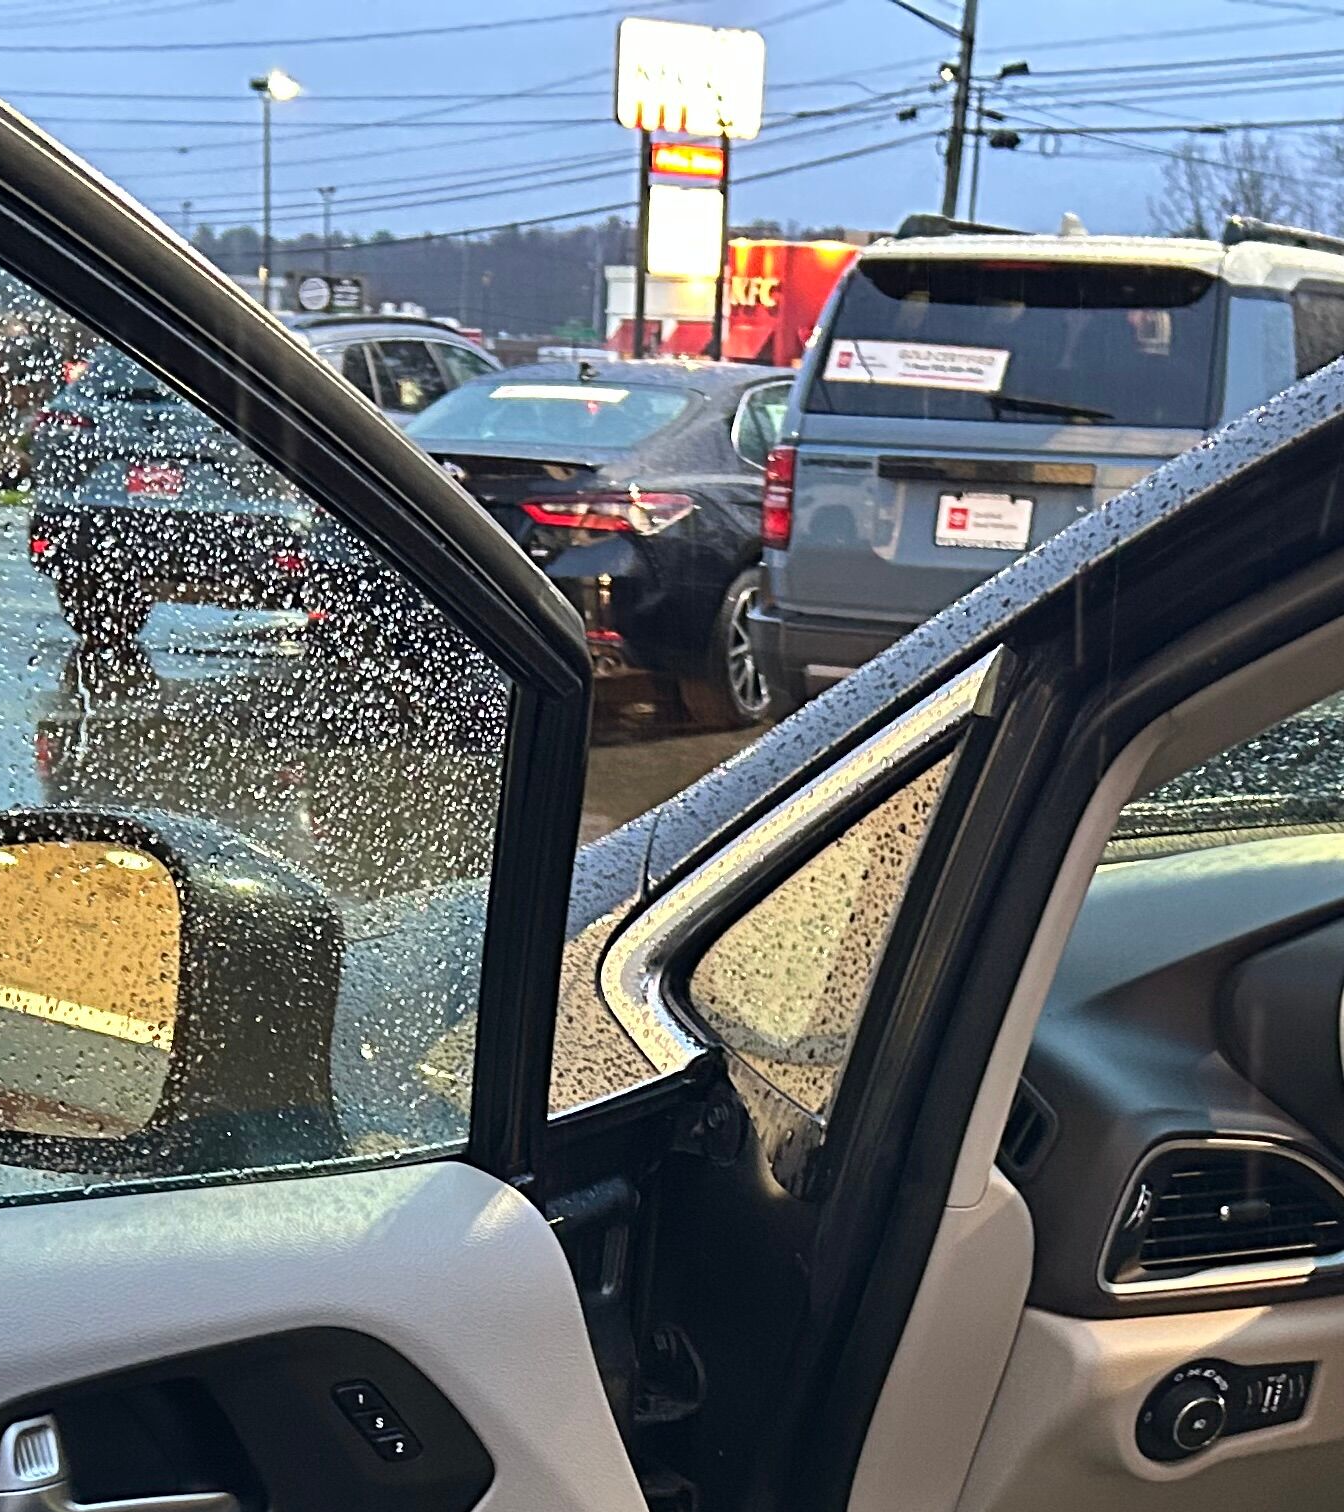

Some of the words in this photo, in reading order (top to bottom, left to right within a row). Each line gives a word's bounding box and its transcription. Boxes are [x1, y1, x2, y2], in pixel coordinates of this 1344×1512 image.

[730, 276, 781, 307] KFC
[358, 1393, 365, 1405] 1
[375, 1417, 384, 1429] S
[395, 1441, 404, 1453] 2
